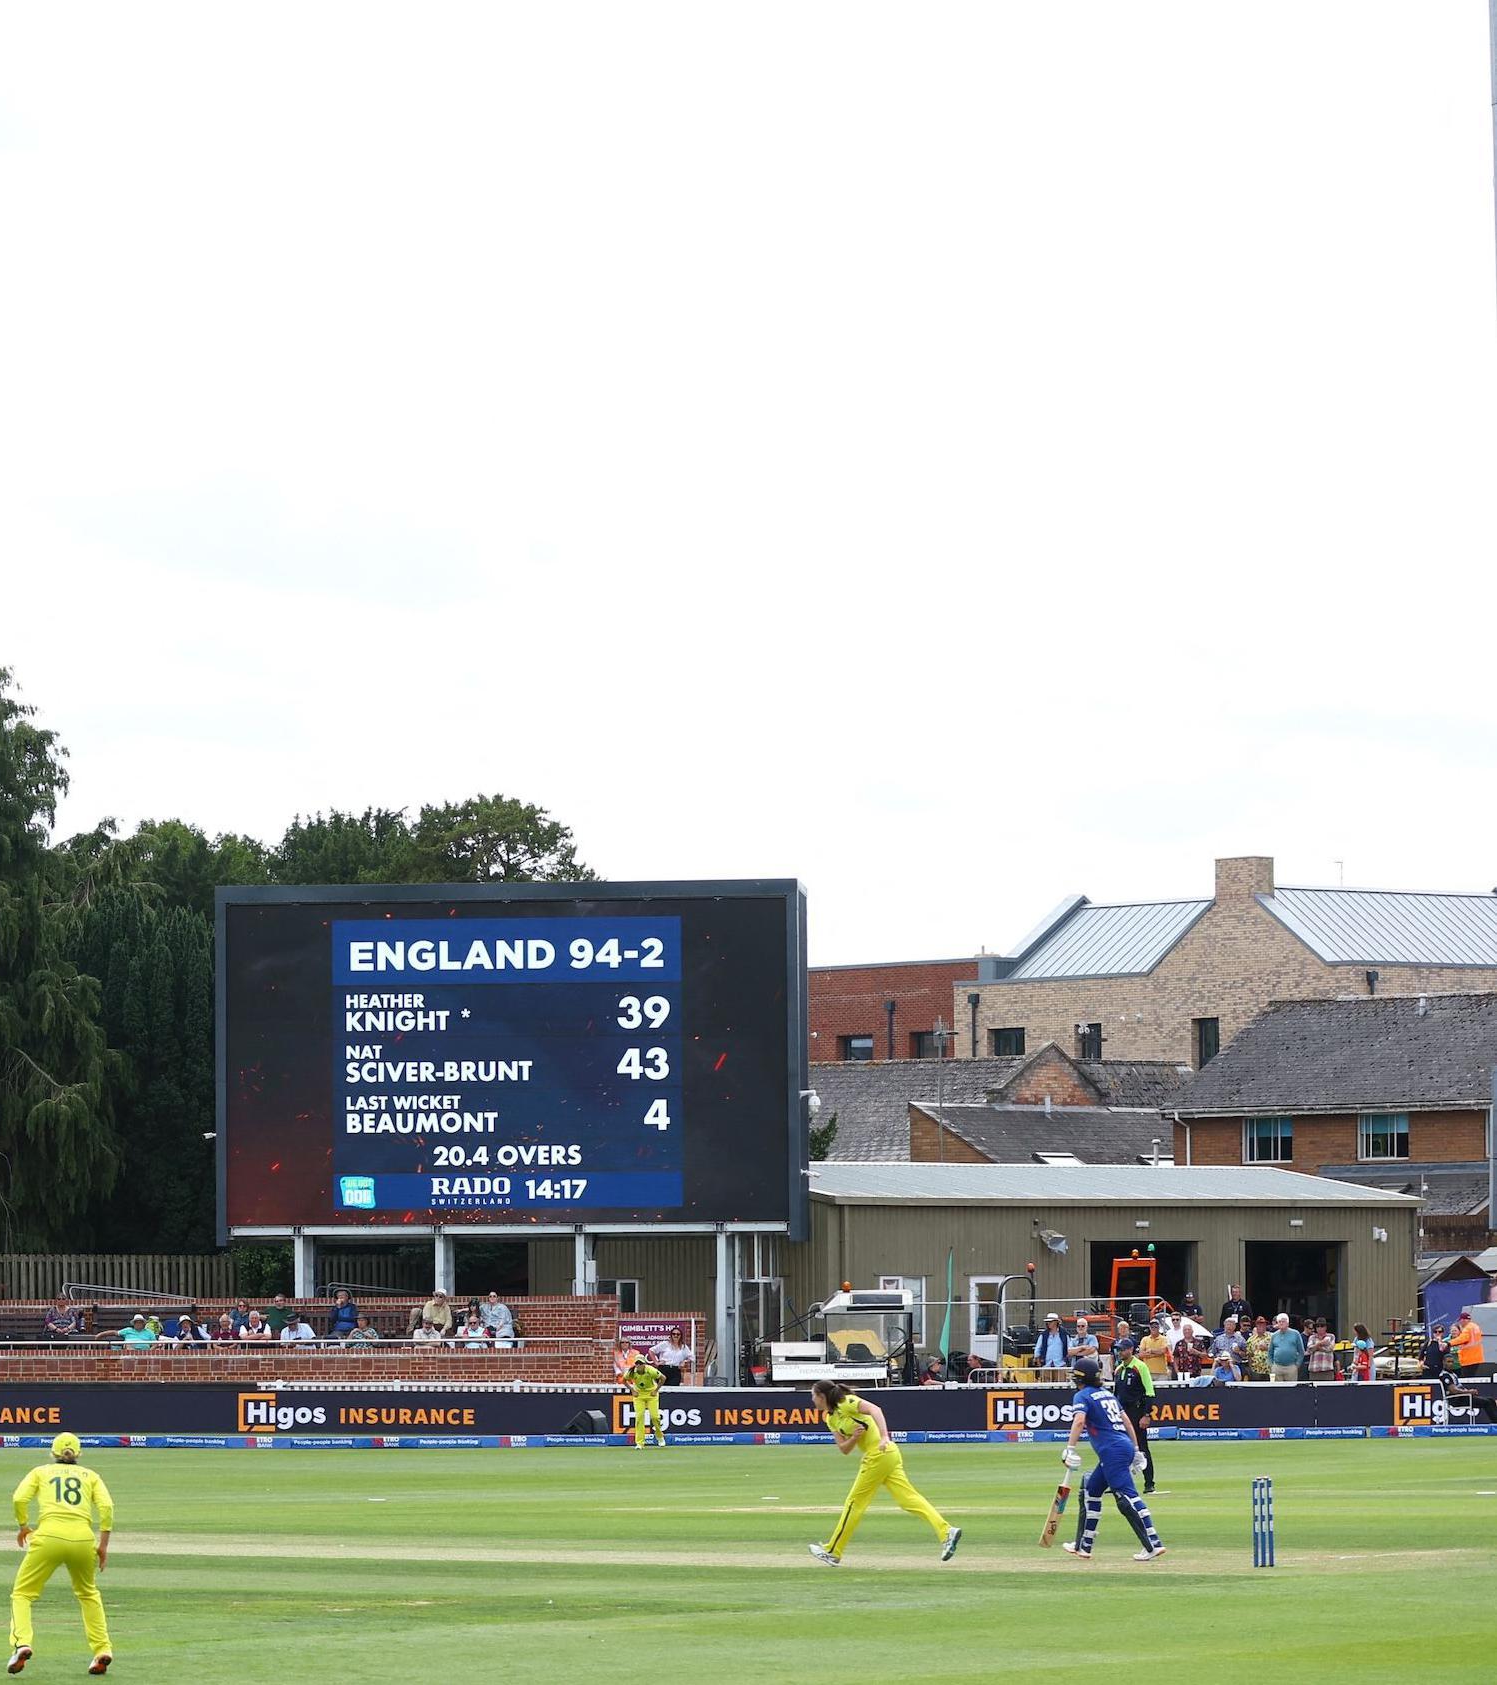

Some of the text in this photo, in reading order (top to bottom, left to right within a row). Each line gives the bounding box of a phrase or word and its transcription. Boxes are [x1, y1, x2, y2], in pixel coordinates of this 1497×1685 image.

[349, 937, 664, 972] ENGLAND 94-2
[345, 993, 425, 1009] HEATHER
[617, 995, 671, 1030] 39
[345, 1010, 450, 1032] KNIGHT
[345, 1044, 383, 1060] NAT
[616, 1046, 670, 1081] 43
[345, 1060, 533, 1084] SCIVER-BRUNT
[345, 1094, 462, 1111] LAST WICKET
[345, 1112, 499, 1134] BEAUMONT
[643, 1098, 671, 1131] 4
[433, 1145, 582, 1167] 20.4 OVERS
[430, 1177, 588, 1200] RADO 14:17
[430, 1197, 511, 1206] SWITZERLAND
[247, 1401, 475, 1430] Higos INSURANCE
[715, 1408, 827, 1425] INSURAN
[996, 1399, 1220, 1428] Higos RANCE
[49, 1477, 81, 1505] 18
